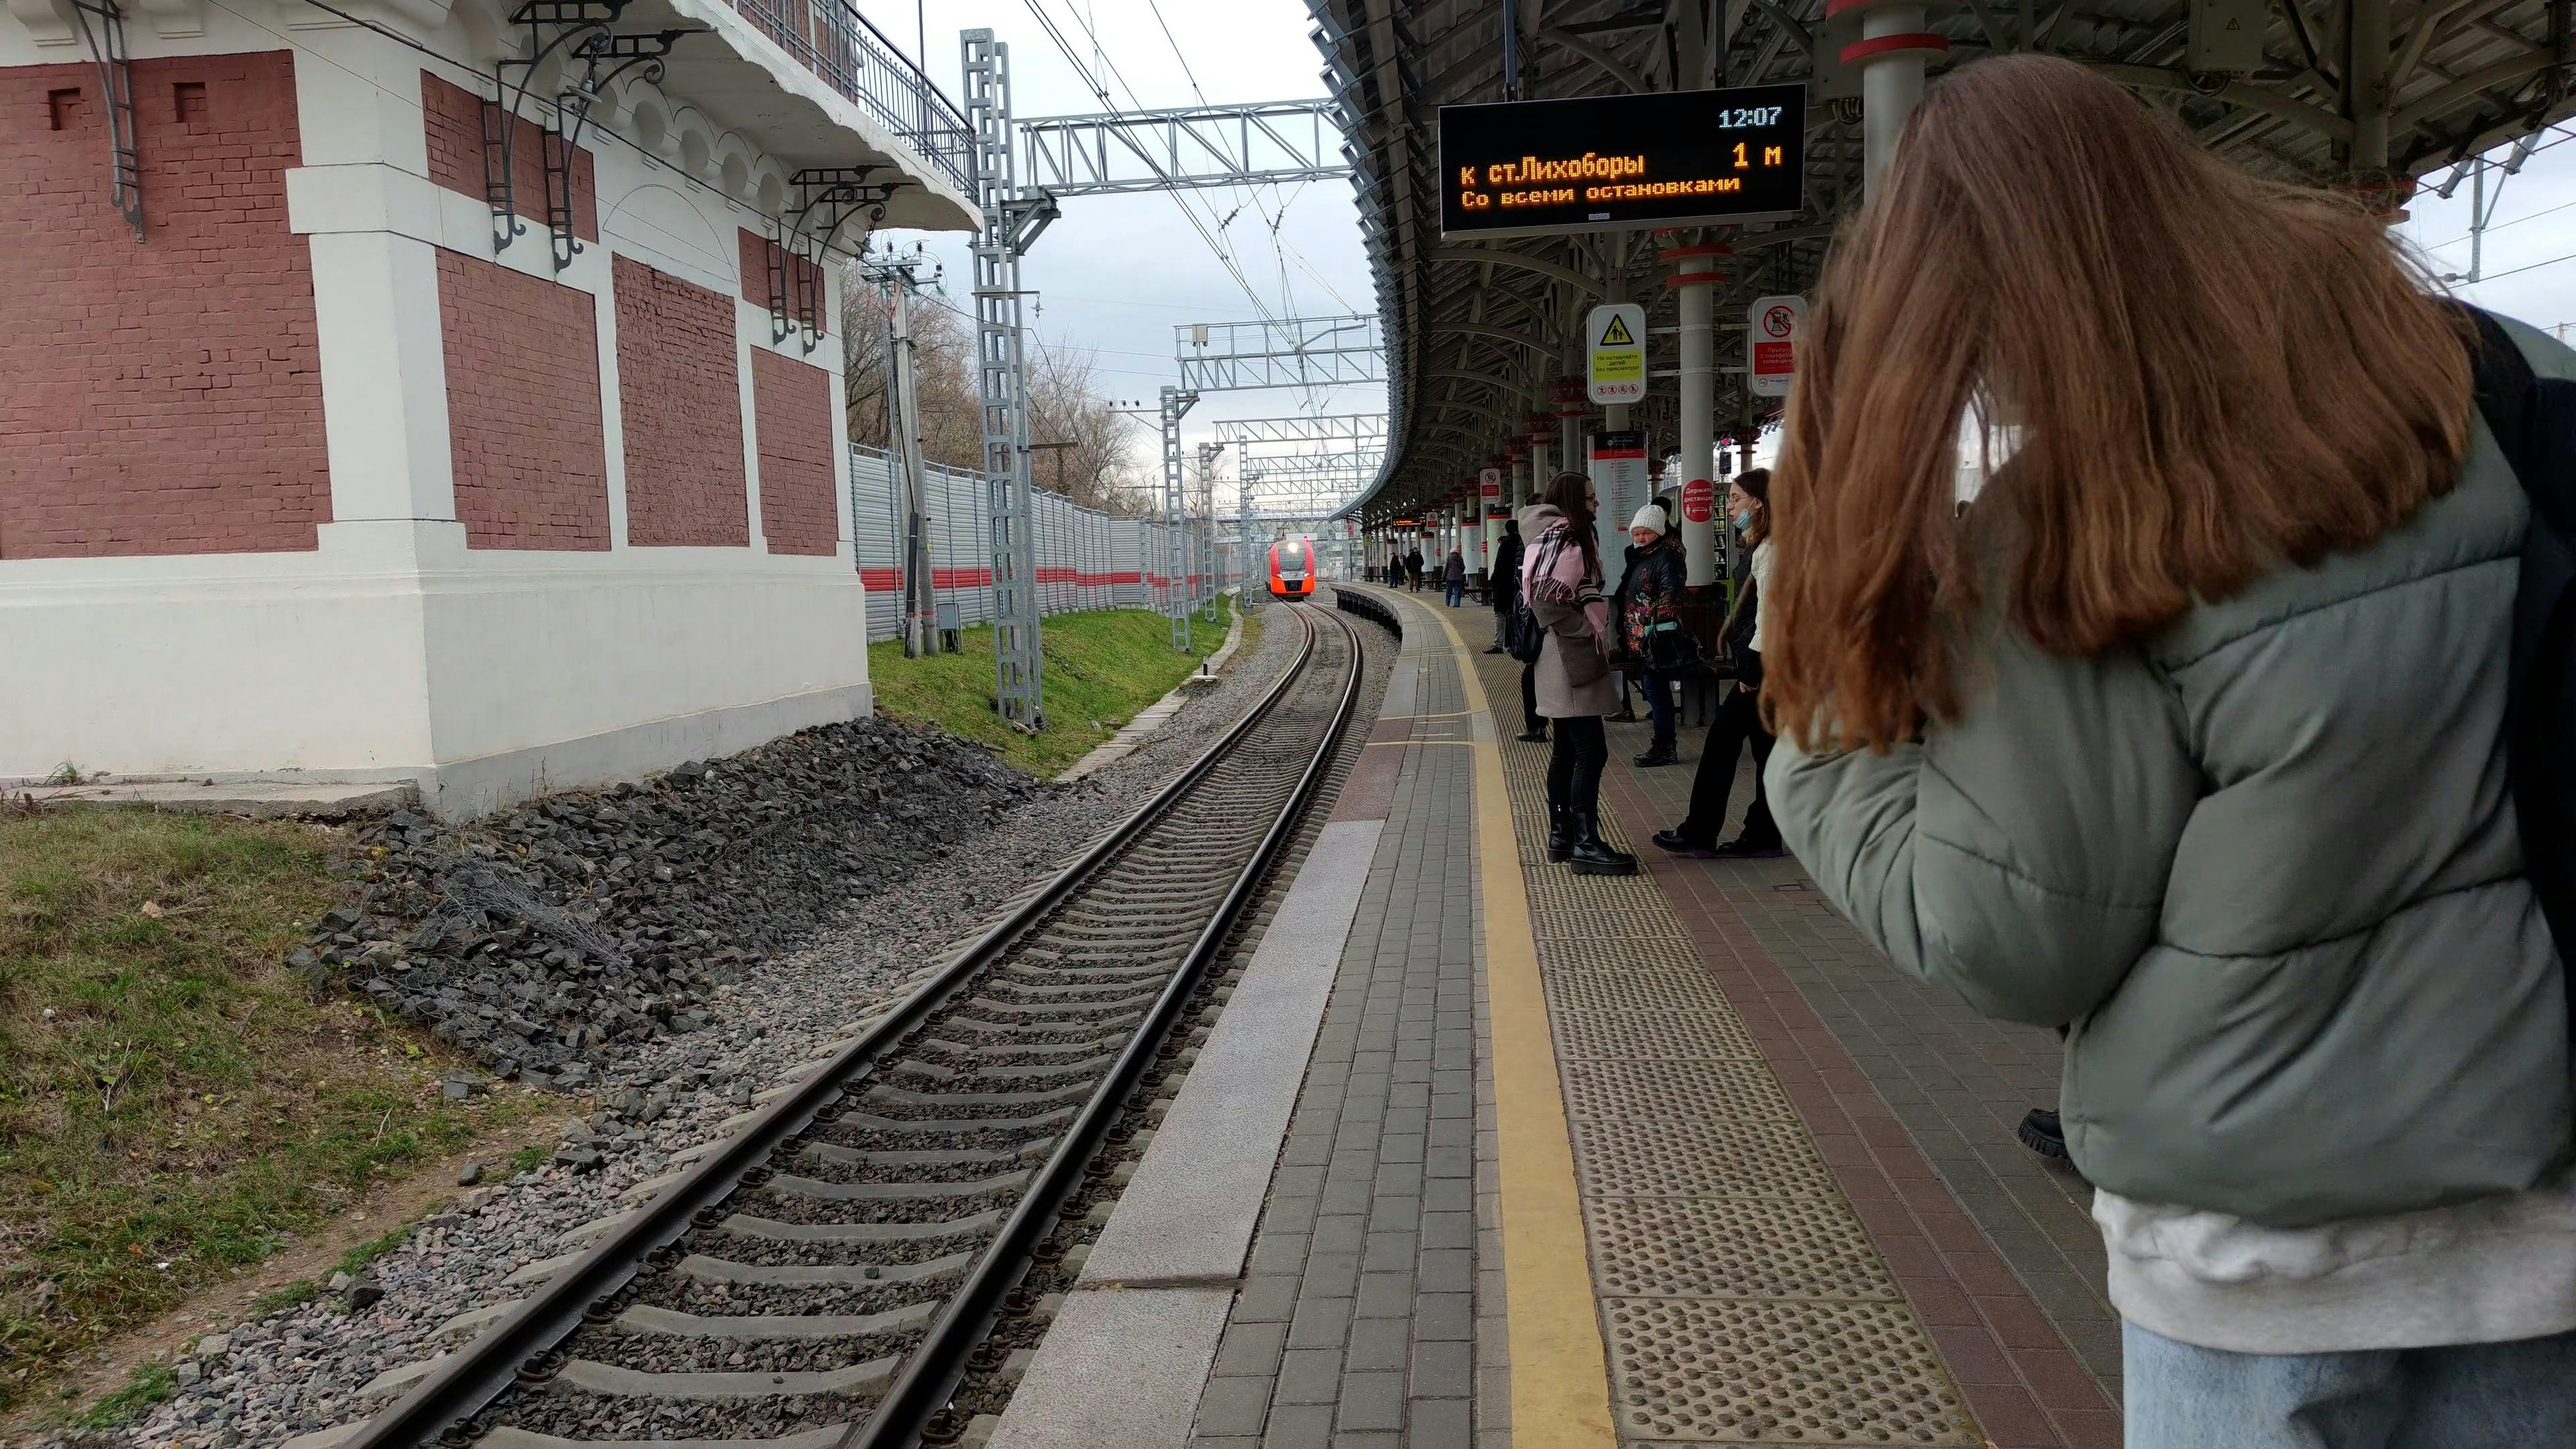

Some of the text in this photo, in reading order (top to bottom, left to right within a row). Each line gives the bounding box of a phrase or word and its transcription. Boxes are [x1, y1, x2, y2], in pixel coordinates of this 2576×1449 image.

[1719, 106, 1782, 128] 12:07
[1489, 152, 1644, 182] ст.Лихоборы
[1733, 142, 1748, 167] 1
[1462, 177, 1740, 207] Со всеми остановками
[1606, 364, 1640, 372] присмотра!
